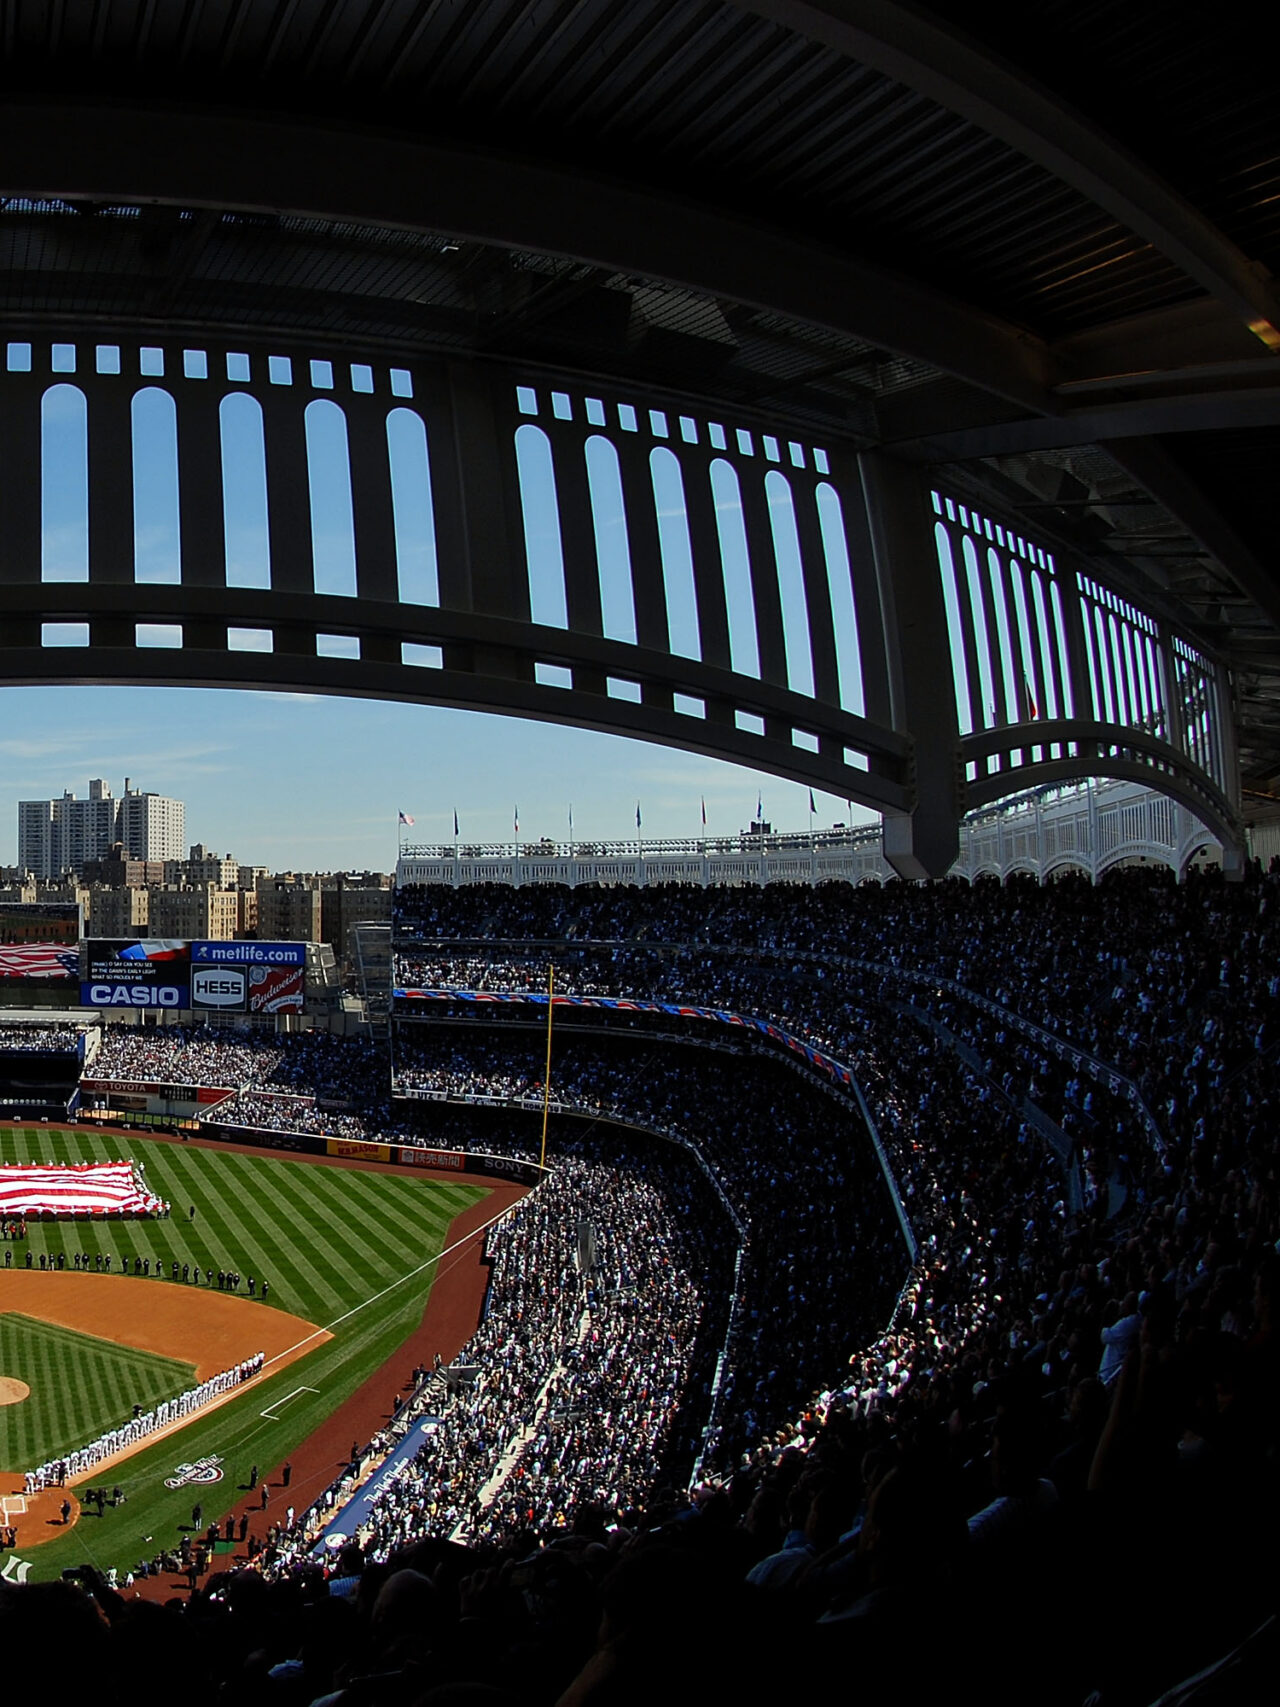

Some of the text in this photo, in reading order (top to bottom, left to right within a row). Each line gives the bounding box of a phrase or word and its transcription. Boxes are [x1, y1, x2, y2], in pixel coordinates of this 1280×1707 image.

[212, 946, 297, 961] metlife.com
[90, 985, 179, 1005] CASIO
[196, 980, 242, 995] HESS
[250, 967, 303, 1011] Budweiser
[110, 1083, 146, 1092] TOYOTA
[523, 1102, 559, 1112] KOMASU
[484, 1157, 523, 1173] SONY
